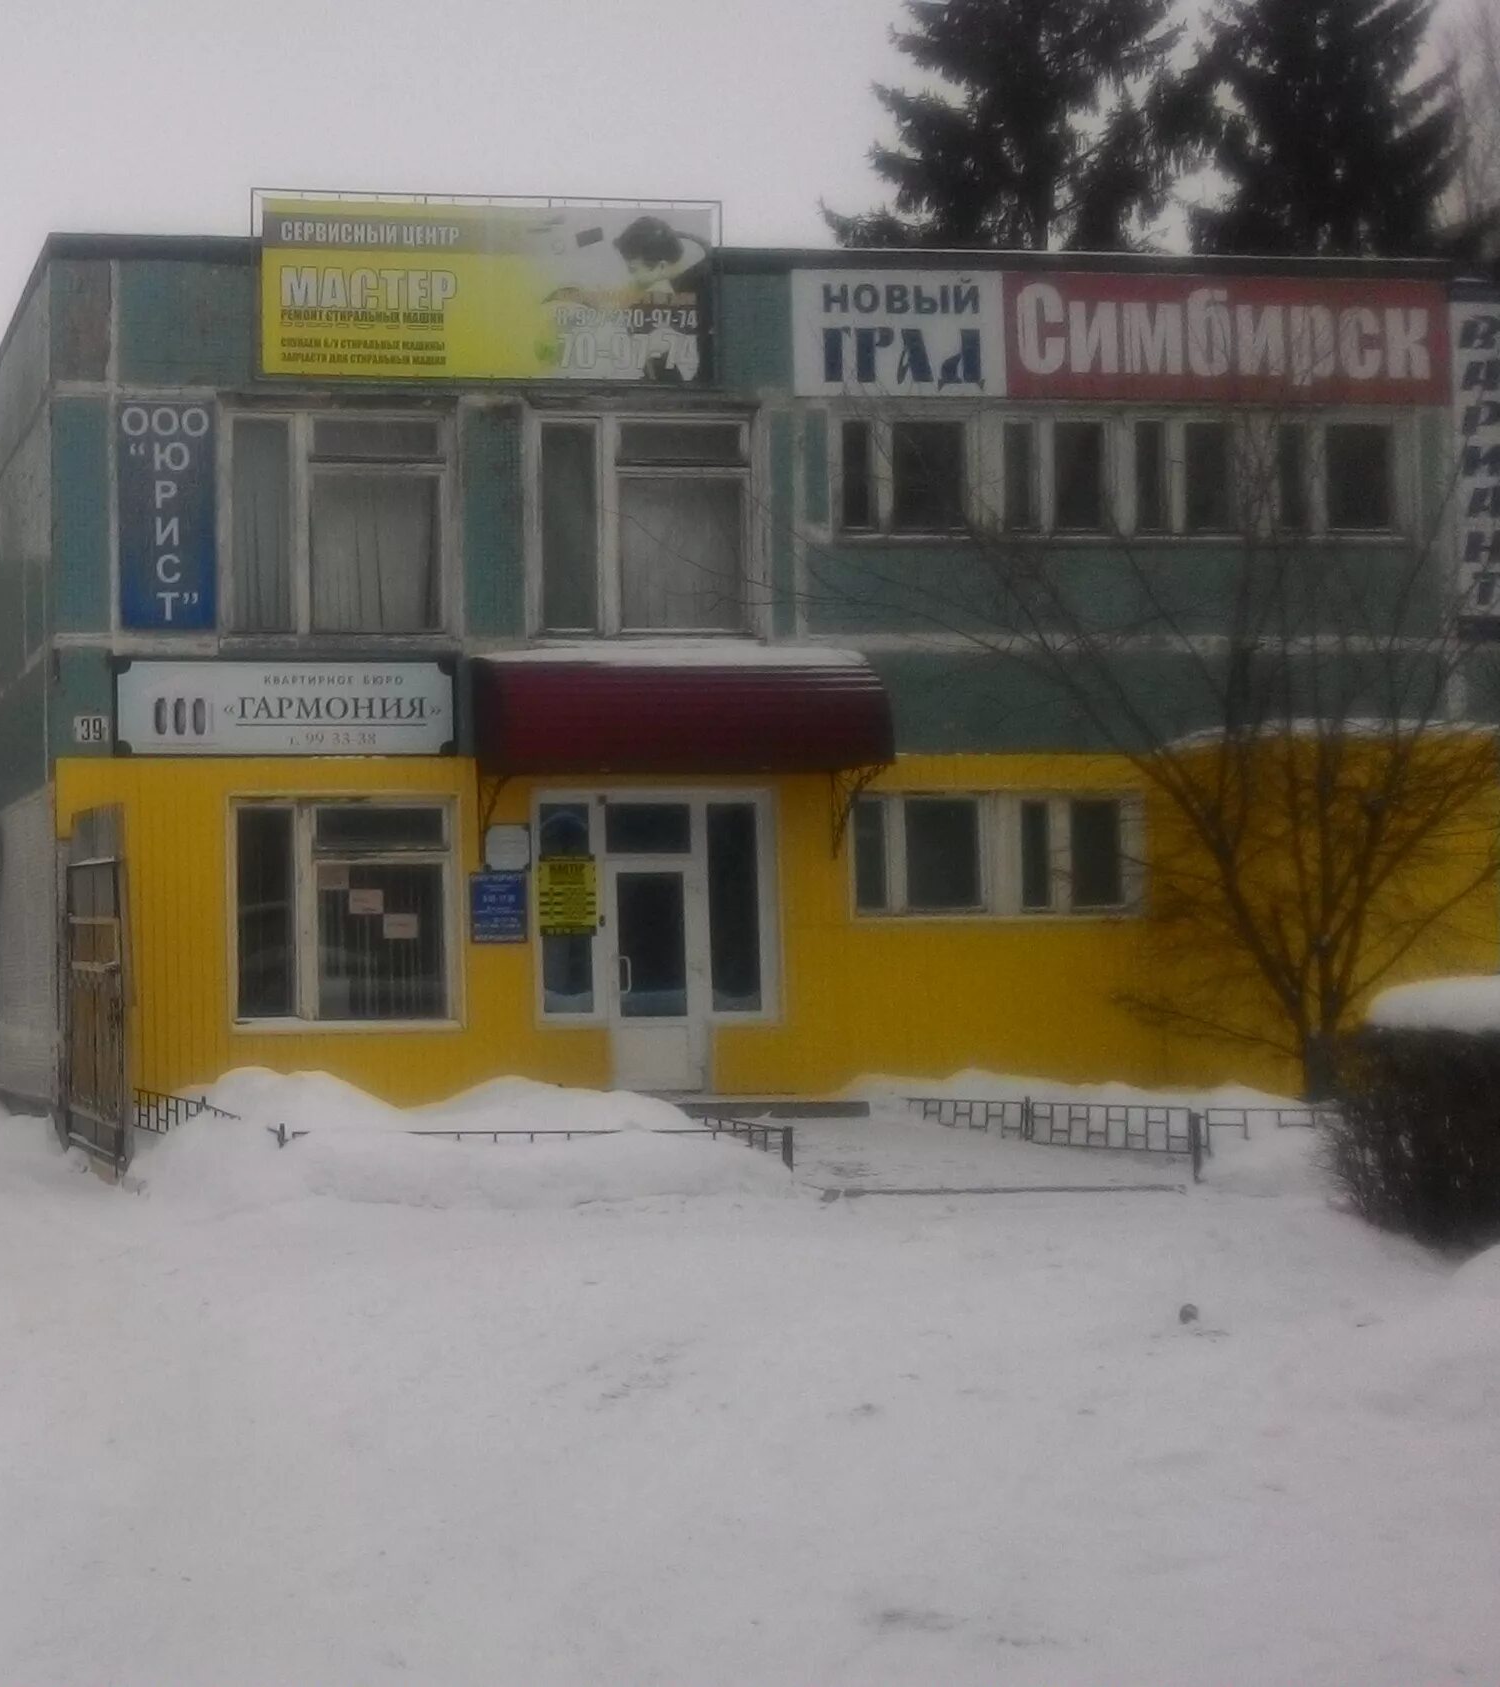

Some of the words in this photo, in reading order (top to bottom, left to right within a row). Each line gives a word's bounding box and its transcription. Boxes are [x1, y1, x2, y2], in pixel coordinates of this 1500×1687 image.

[281, 221, 397, 244] СЕРВИСНЫЙ
[402, 225, 460, 246] ЦЕНТР
[280, 265, 457, 312] МАСТЕР
[822, 277, 980, 314] НОВЫЙ
[281, 309, 323, 321] РЕМОНТ
[326, 310, 400, 323] СТИРАЛЬНЫХ
[403, 313, 444, 324] МАШИН
[1017, 283, 1431, 386] Симбирск
[822, 326, 986, 391] ГРАД
[121, 407, 209, 437] ООО
[264, 675, 354, 686] КВАРТИРНОЕ
[363, 675, 405, 686] БЮРО
[223, 696, 441, 720] «ГАРМОНИЯ»
[81, 718, 102, 740] 39
